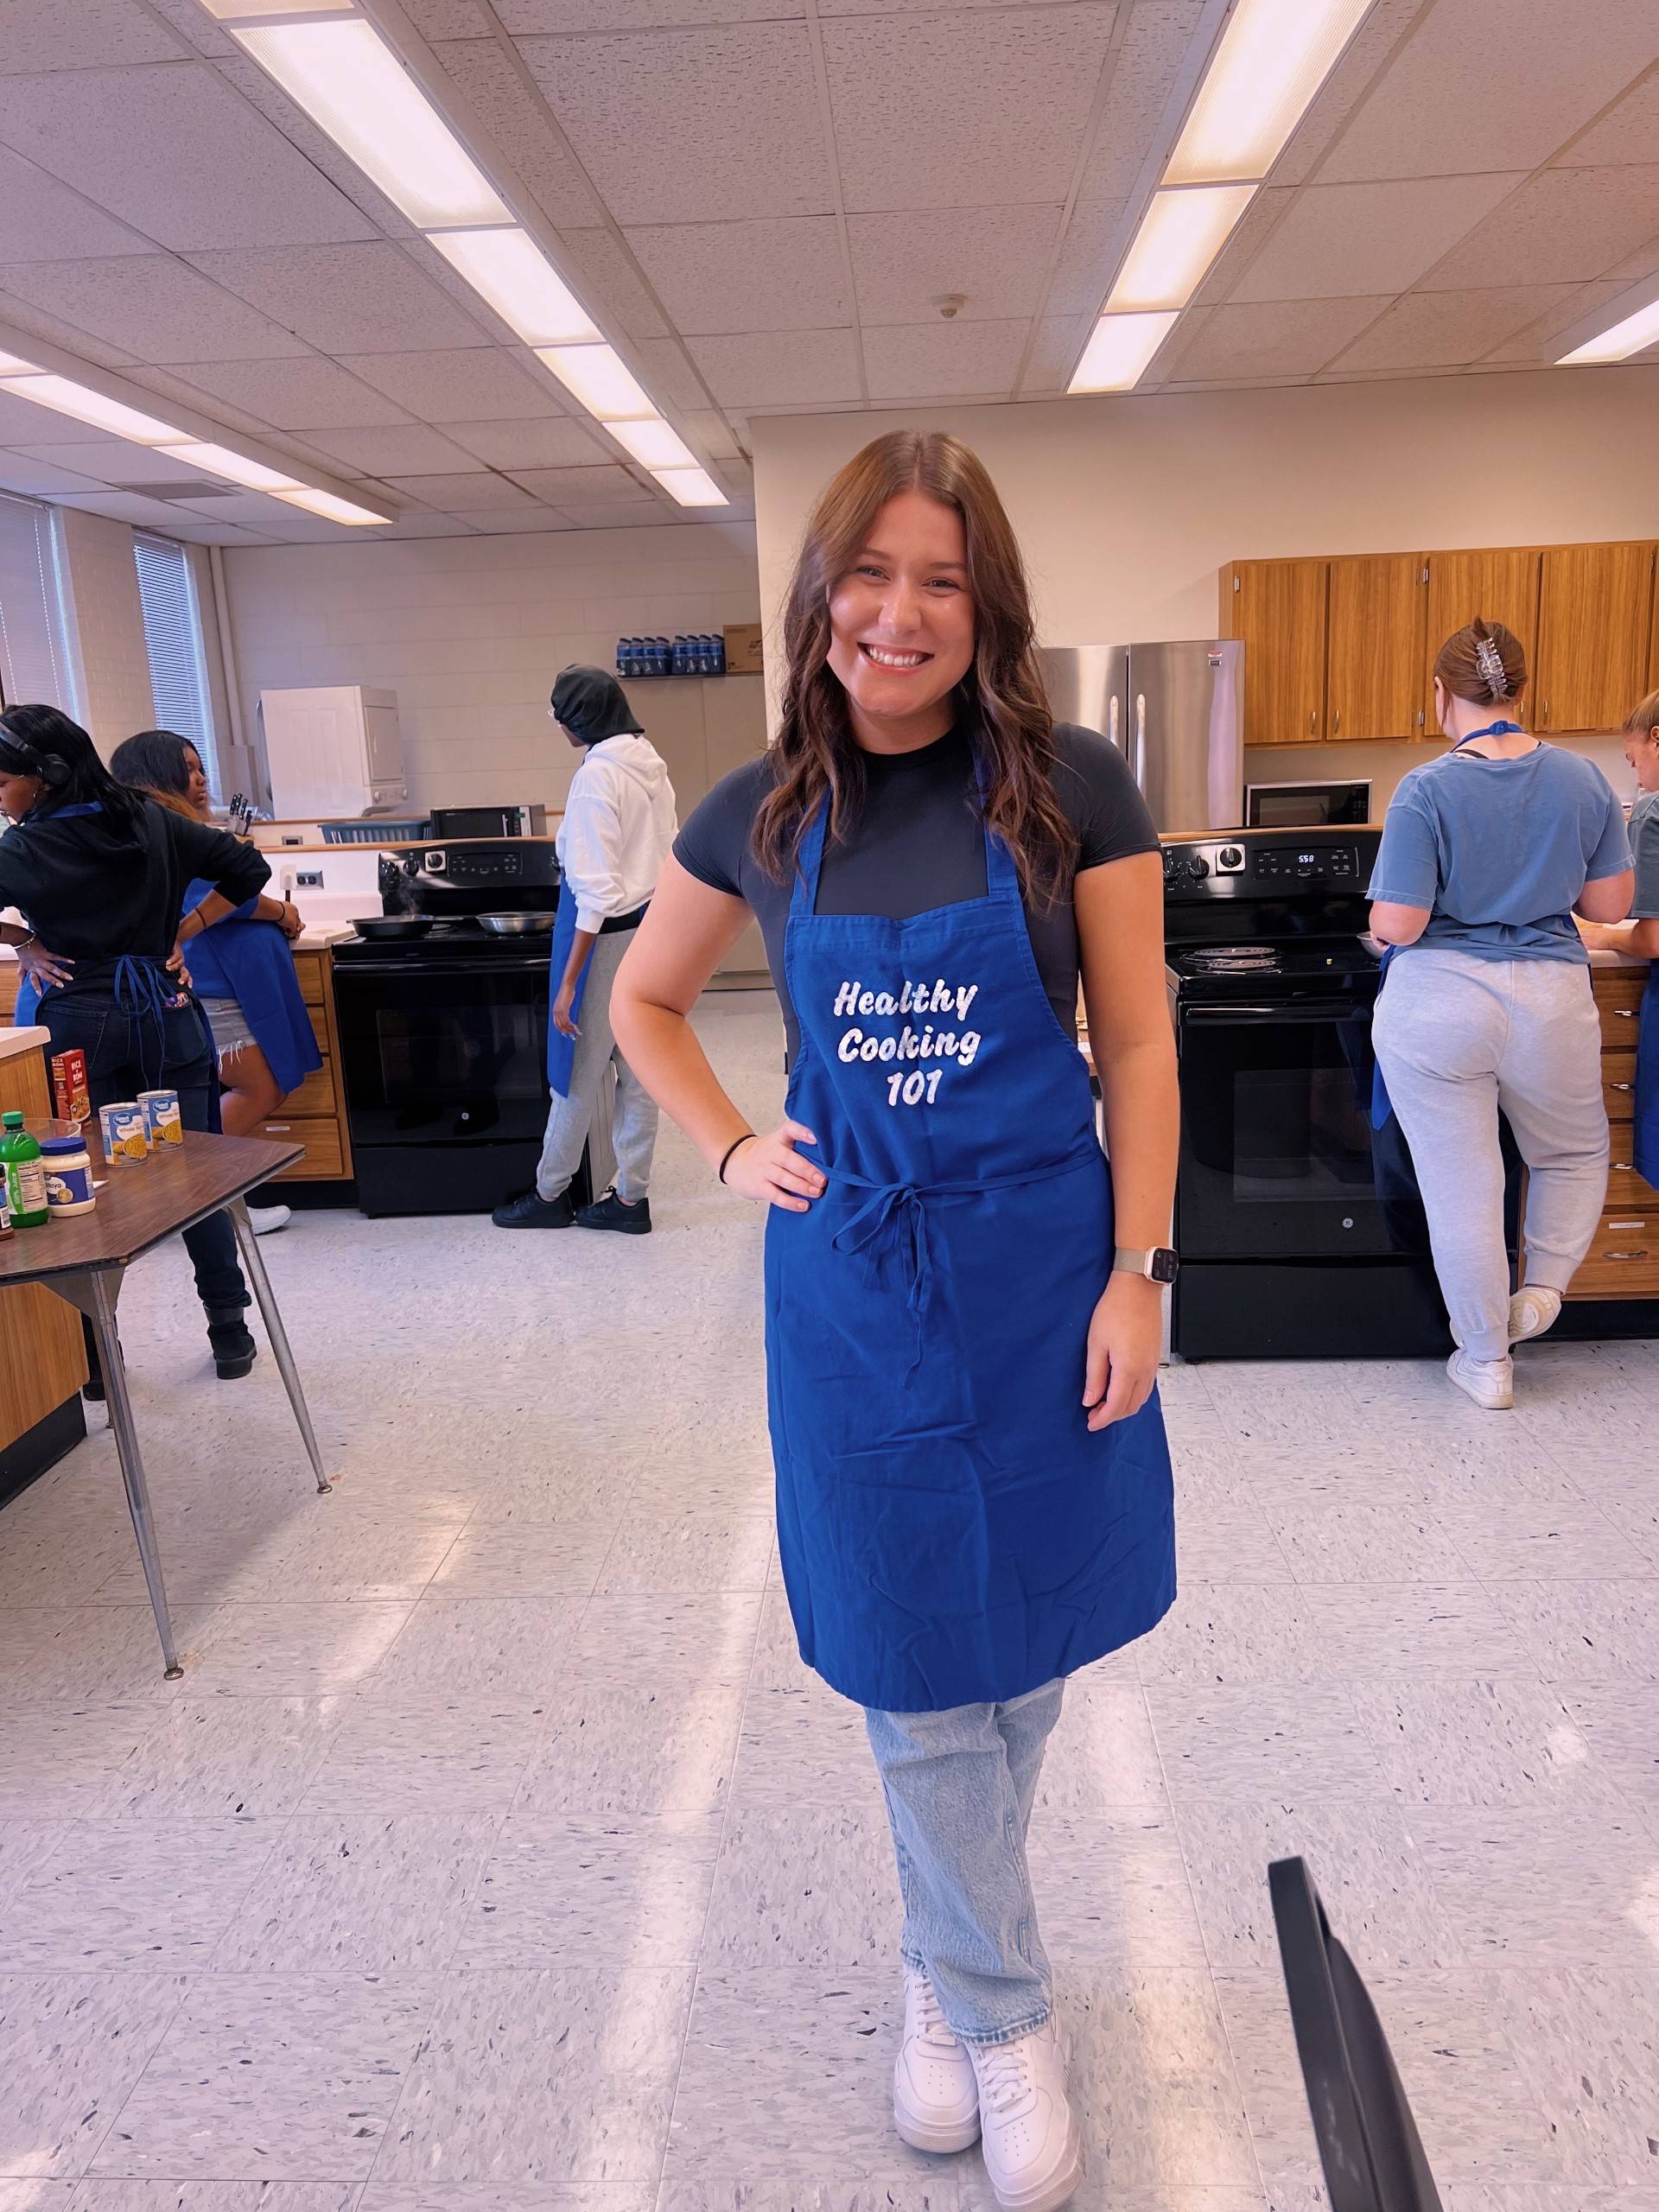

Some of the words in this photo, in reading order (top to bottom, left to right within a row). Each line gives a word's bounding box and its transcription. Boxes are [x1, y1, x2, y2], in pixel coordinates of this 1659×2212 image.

[833, 978, 978, 1021] Healthy
[837, 1025, 982, 1066] Cooking
[887, 1068, 943, 1107] 101
